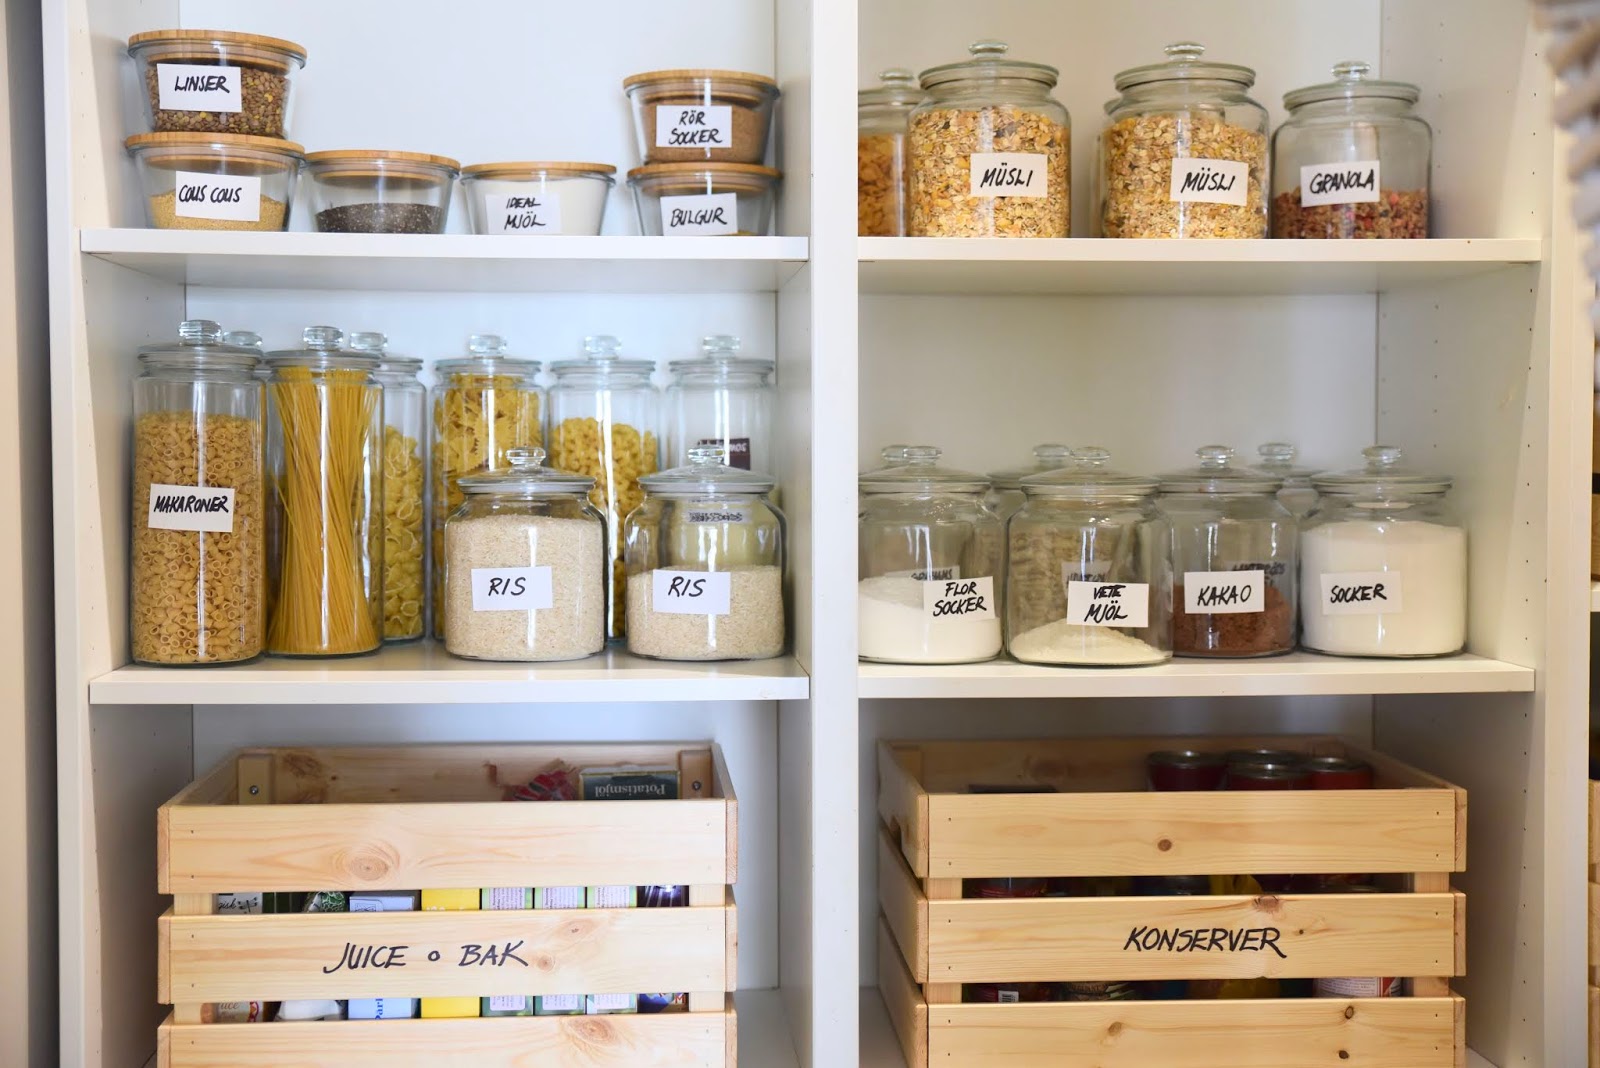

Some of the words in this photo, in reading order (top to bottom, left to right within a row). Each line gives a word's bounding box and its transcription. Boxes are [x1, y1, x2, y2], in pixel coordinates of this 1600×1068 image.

[175, 76, 230, 93] LINSER
[679, 110, 705, 125] RÖR
[669, 128, 722, 145] SOCKER
[980, 163, 1033, 187] MÜSLI
[1181, 167, 1235, 193] MÜSLI
[1310, 169, 1374, 194] GRANOLA
[179, 185, 207, 202] COUS
[210, 187, 242, 203] COUS
[506, 197, 541, 208] IDEAL
[504, 211, 545, 230] MJÖL
[671, 207, 727, 227] BULGUR
[154, 495, 229, 513] MAKARONER
[488, 577, 526, 596] RIS
[668, 576, 706, 597] RIS
[945, 581, 978, 597] FLOR
[1094, 585, 1126, 599] VETE
[1197, 585, 1251, 606] KAKAO
[1330, 584, 1387, 603] SOCKER
[932, 598, 988, 617] SOCKER
[1084, 600, 1128, 623] MJÖL
[595, 783, 666, 797] Potatismjöl
[1124, 926, 1287, 958] KONSERVER
[323, 943, 408, 974] JUICE
[459, 941, 528, 966] BAK
